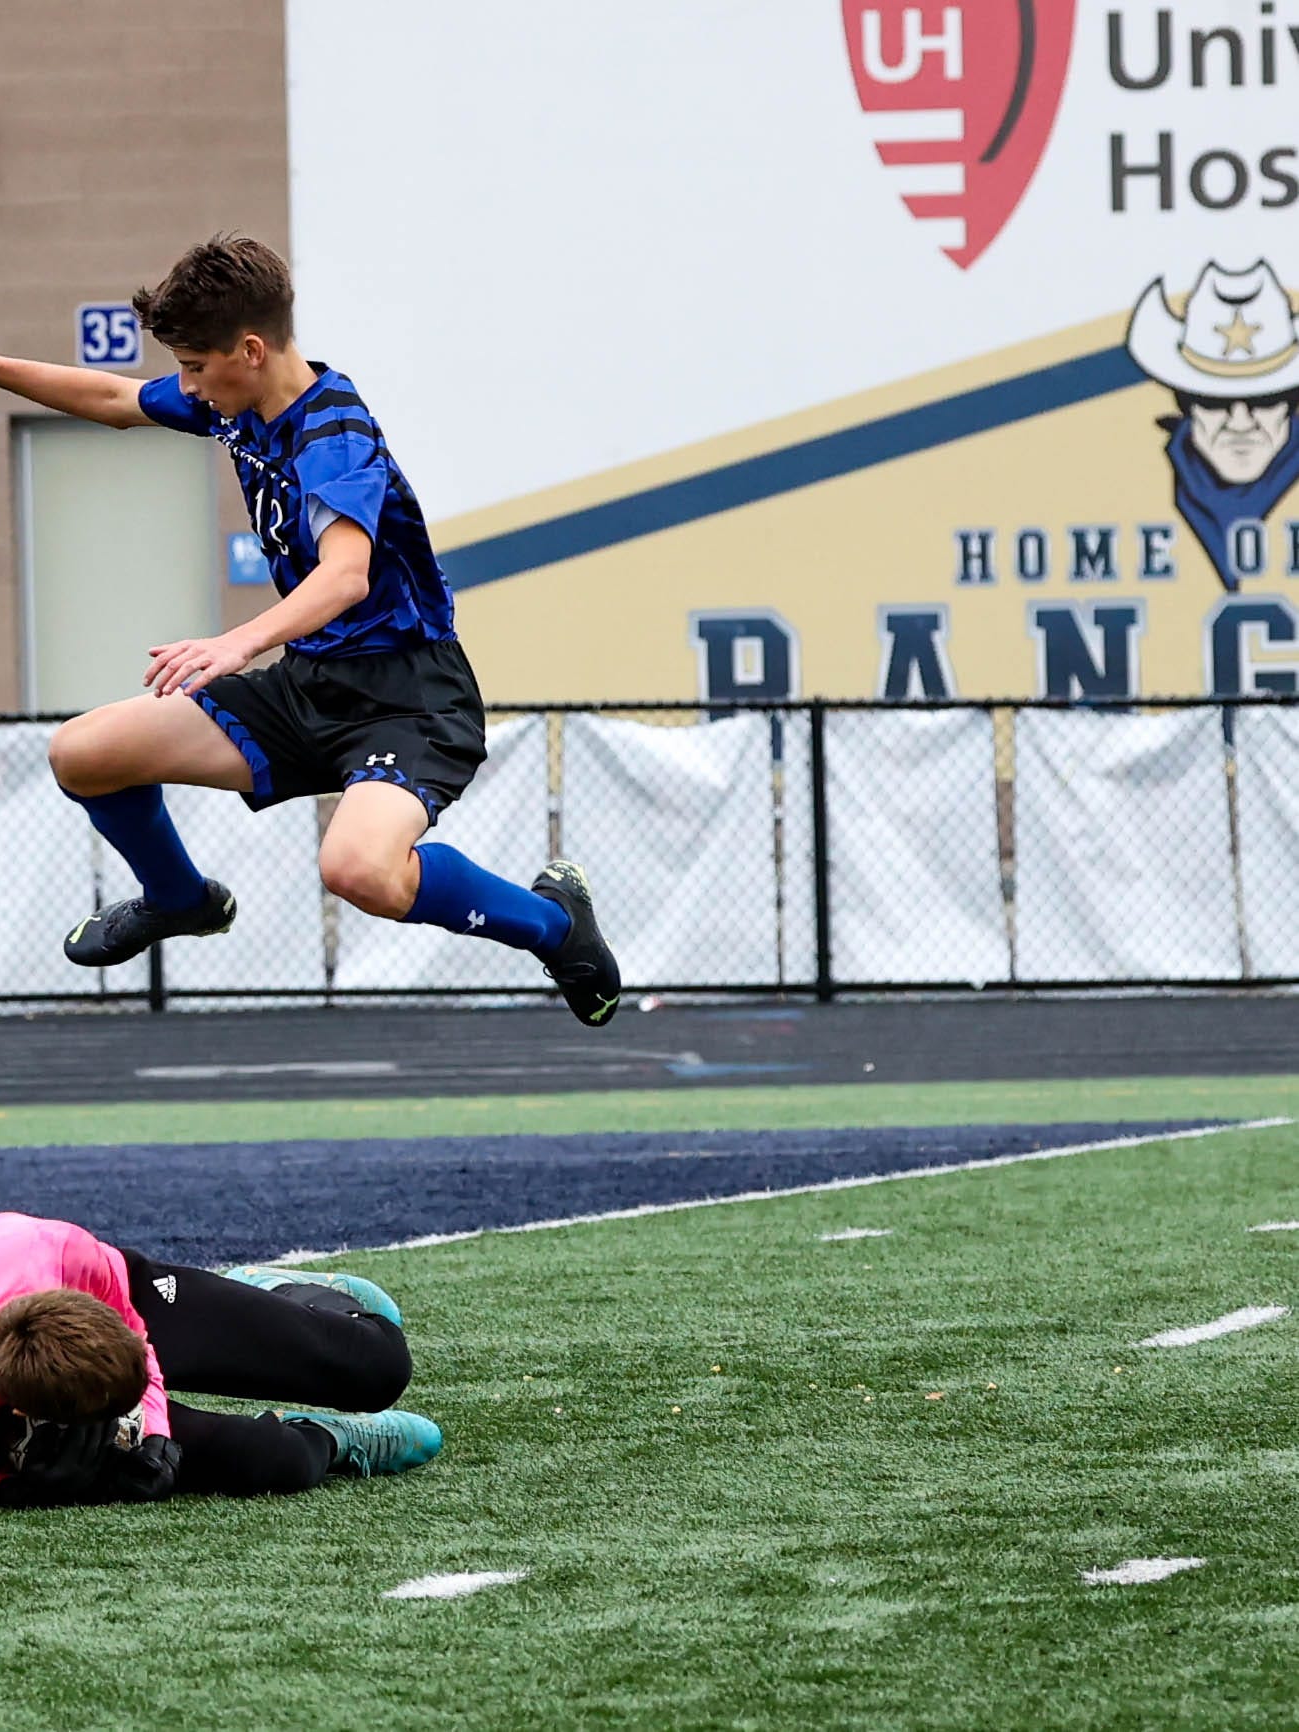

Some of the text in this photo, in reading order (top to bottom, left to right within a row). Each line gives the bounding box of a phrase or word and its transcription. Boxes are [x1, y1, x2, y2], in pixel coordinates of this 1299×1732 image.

[861, 6, 965, 83] UH
[1106, 2, 1299, 91] Uni
[1108, 130, 1299, 212] Hos
[84, 310, 137, 360] 35
[955, 520, 1299, 586] HOME O
